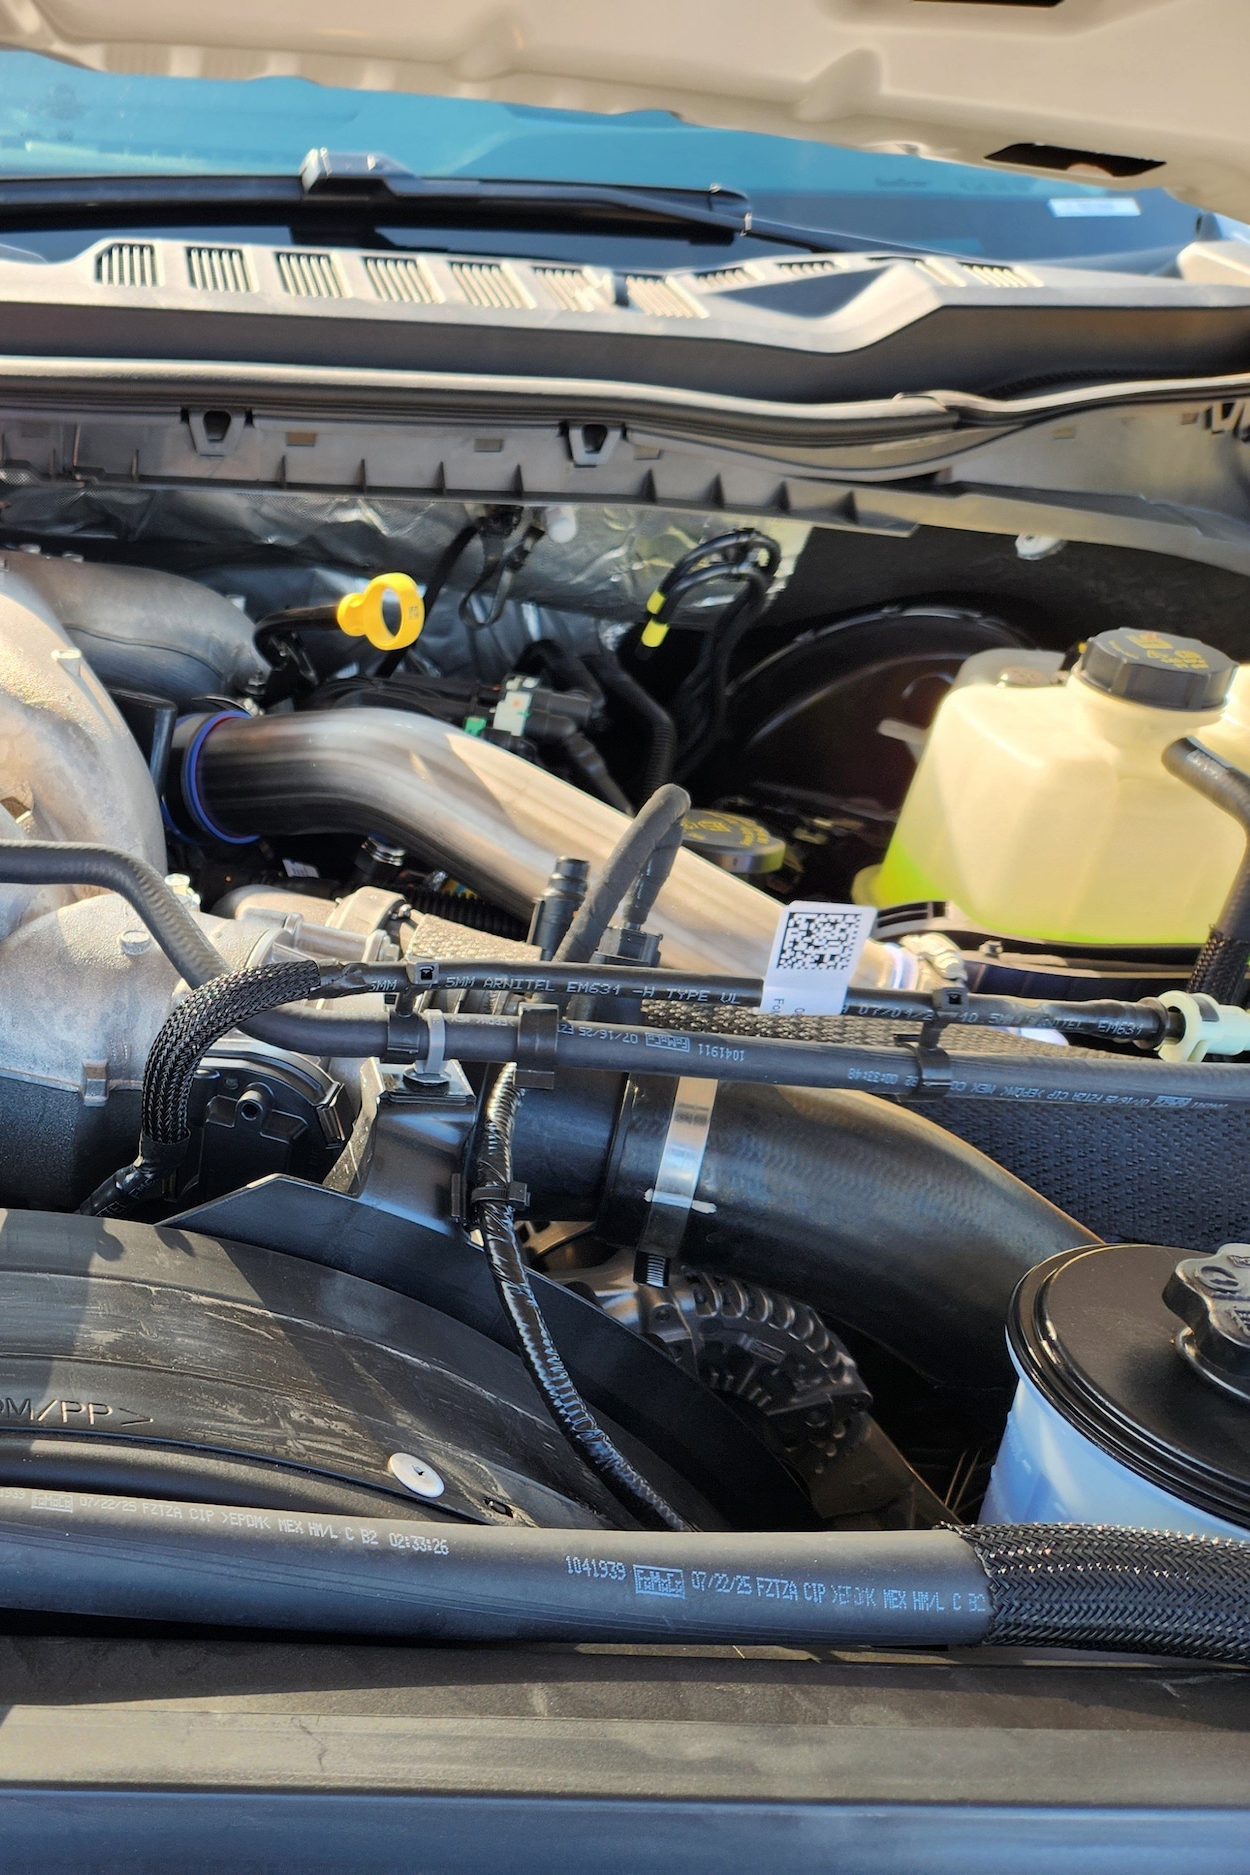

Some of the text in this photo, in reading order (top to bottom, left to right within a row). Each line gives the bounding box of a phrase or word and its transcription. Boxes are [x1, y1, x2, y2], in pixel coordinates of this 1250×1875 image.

[483, 976, 555, 992] ARNITEL
[566, 981, 621, 996] EM631
[667, 988, 711, 1002] TYPE
[858, 1005, 935, 1021] 07/01/2
[579, 1027, 639, 1044] 07/16/25
[1097, 1019, 1144, 1036] EM631
[697, 1043, 746, 1063] 1041911
[971, 1083, 997, 1095] MEX
[79, 1496, 137, 1513] 07/22/25
[142, 1502, 182, 1519] FZTZA
[189, 1508, 215, 1522] CIP
[278, 1517, 304, 1535] MEX
[345, 1526, 355, 1541] C
[361, 1528, 379, 1545] B2
[389, 1532, 450, 1556] 02:33:26
[565, 1555, 627, 1581] 1041939
[691, 1570, 753, 1595] 07/22/25
[756, 1576, 799, 1601] FZTZA
[803, 1582, 826, 1603] CIP
[882, 1588, 907, 1609] MEX
[952, 1592, 963, 1611] C
